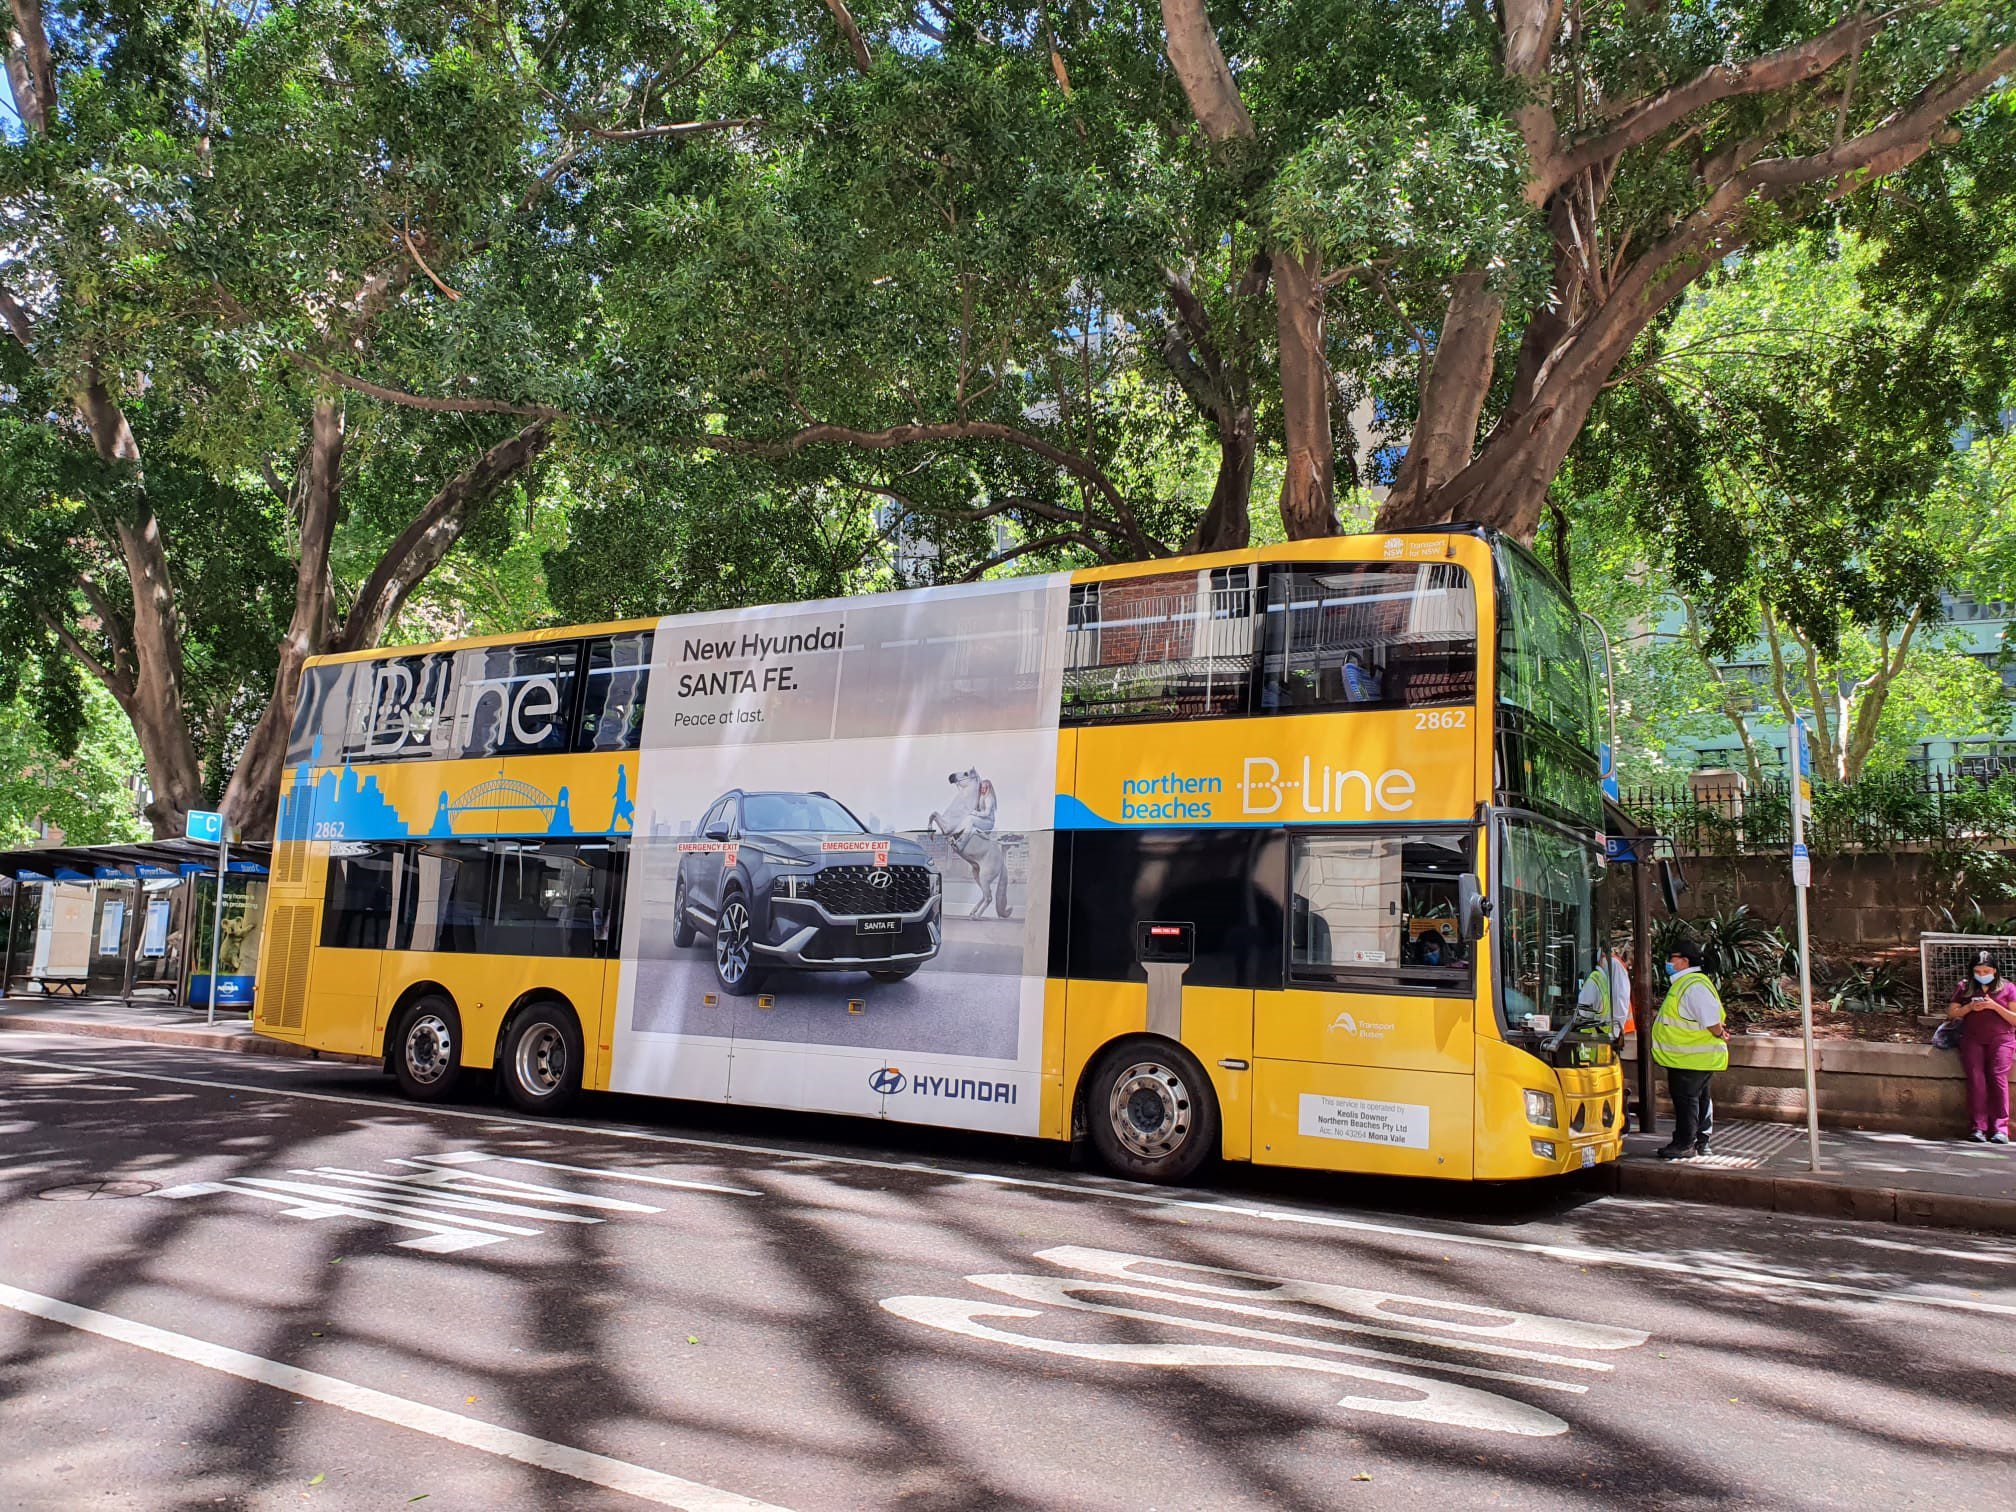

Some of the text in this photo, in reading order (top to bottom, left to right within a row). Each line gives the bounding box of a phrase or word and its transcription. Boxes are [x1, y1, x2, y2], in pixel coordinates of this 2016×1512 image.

[1422, 548, 1441, 556] NSW
[682, 623, 844, 662] New Hyundai
[677, 666, 798, 698] SANTA FE.
[674, 708, 765, 727] Peace at last.
[1415, 710, 1466, 730] 2862
[1122, 772, 1222, 795] northern
[1122, 797, 1212, 819] beaches
[206, 816, 217, 832] C
[315, 821, 345, 838] 2862
[679, 843, 738, 851] EMERGENCY EXIT
[822, 841, 888, 850] EMERGENCY EXIT
[1607, 839, 1617, 853] B
[864, 921, 896, 930] SANTA FE
[913, 1074, 1017, 1105] HYUNDAI
[1321, 1097, 1334, 1106] This
[1335, 1099, 1359, 1109] service
[1367, 1102, 1396, 1112] operated
[1396, 1104, 1405, 1114] by
[1318, 1116, 1408, 1133] Northern Beaches Pty Ltd
[1337, 1110, 1388, 1122] Keolis Downer
[1368, 1132, 1388, 1141] Mona
[1390, 1134, 1406, 1143] Vale
[878, 1244, 1652, 1437] BUS
